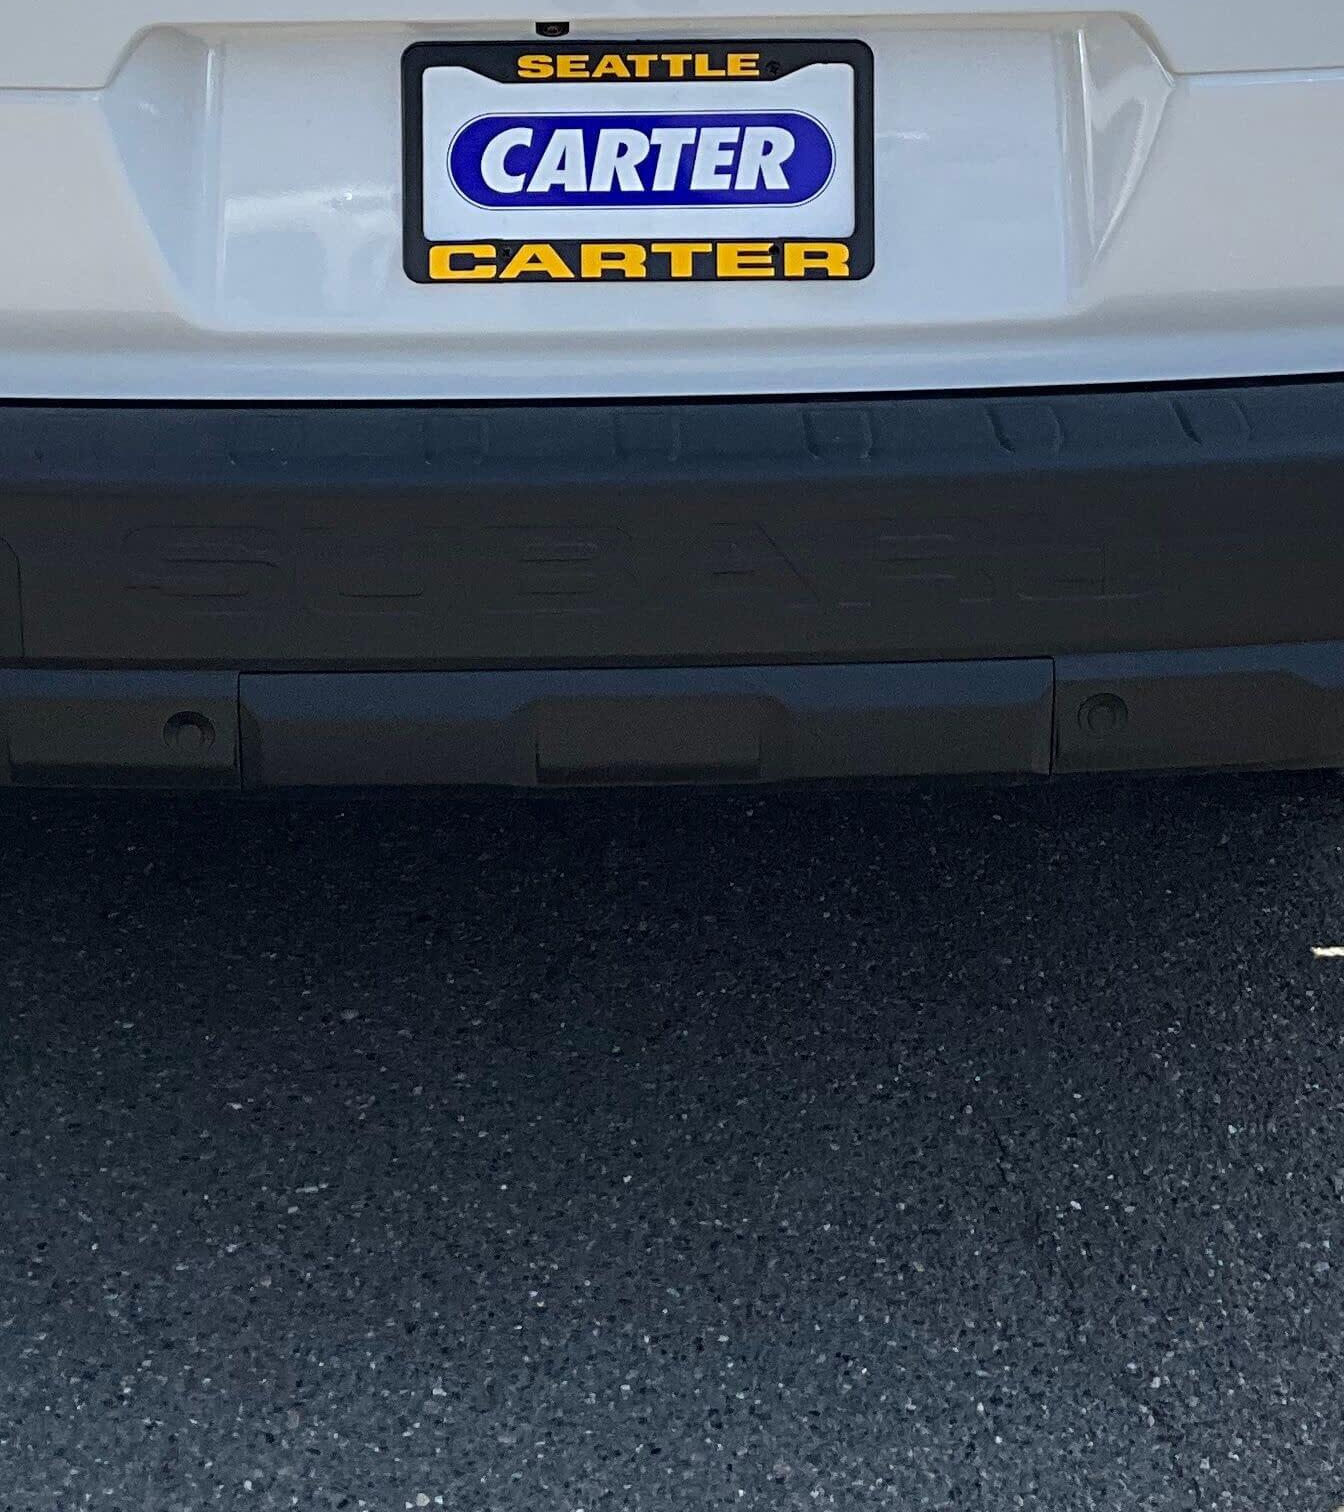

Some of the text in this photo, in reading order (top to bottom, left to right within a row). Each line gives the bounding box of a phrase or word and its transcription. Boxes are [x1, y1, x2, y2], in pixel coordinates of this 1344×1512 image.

[516, 52, 761, 79] SEATTLE
[479, 125, 796, 194] CARTER
[428, 241, 851, 280] CARTER
